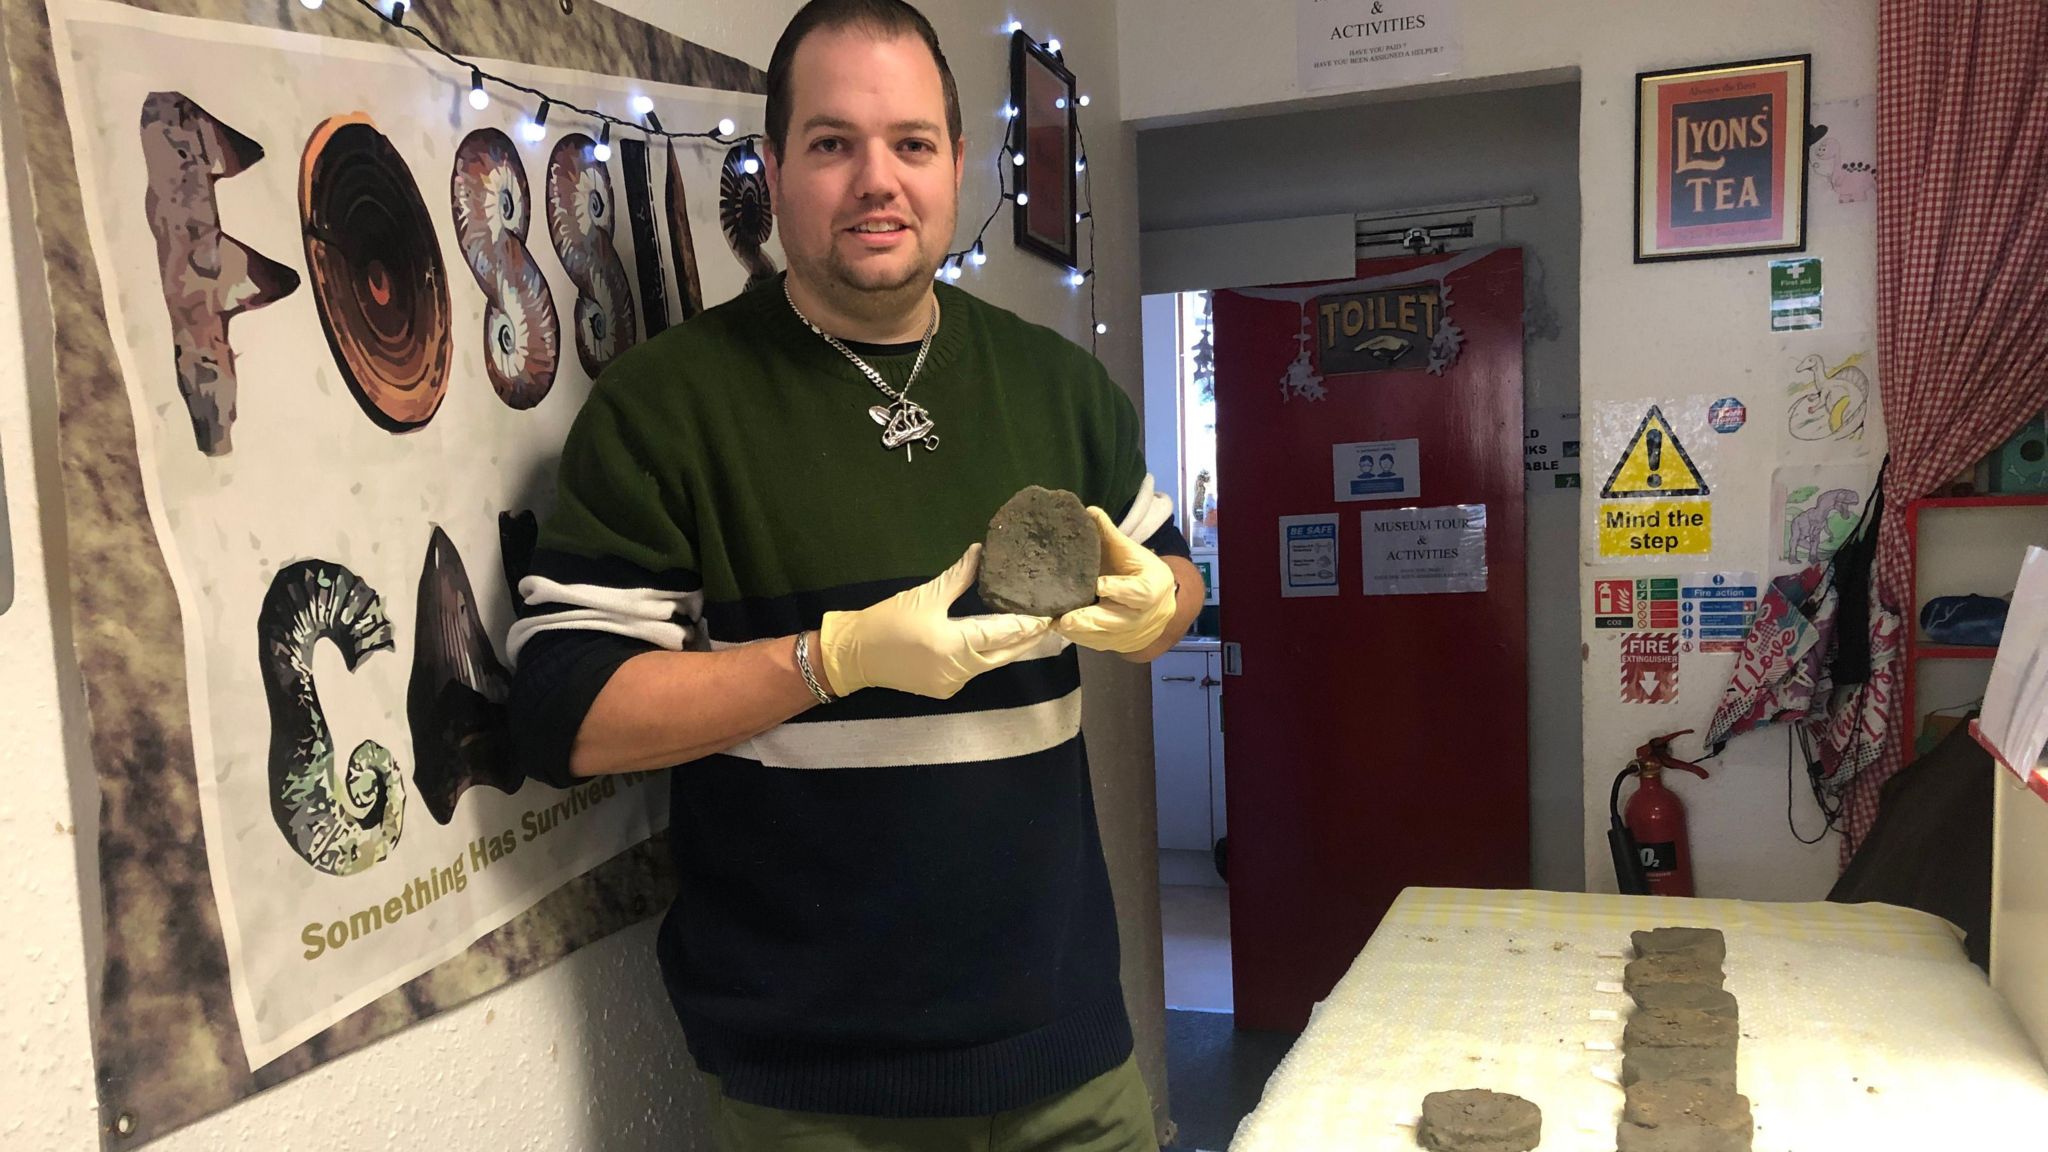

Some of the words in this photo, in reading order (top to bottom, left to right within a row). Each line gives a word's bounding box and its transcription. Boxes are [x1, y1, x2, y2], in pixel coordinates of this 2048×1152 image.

[1370, 1, 1383, 15] &
[1330, 14, 1426, 40] ACTIVITIES
[1685, 176, 1760, 212] TEA
[1320, 293, 1438, 349] TOILET
[1373, 520, 1431, 533] MUSEUM
[1434, 518, 1469, 530] TOUR
[1606, 511, 1660, 528] Mind
[1668, 510, 1704, 527] the
[1416, 536, 1427, 545] &
[1630, 533, 1679, 552] step
[1386, 548, 1459, 561] ACTIVITIES
[1694, 589, 1711, 597] Fire
[1715, 589, 1744, 597] action
[1629, 640, 1669, 654] FIRE
[1622, 655, 1679, 664] EXTINGUISHER
[300, 852, 467, 961] Something
[469, 826, 517, 874] Has
[522, 774, 616, 842] Survived
